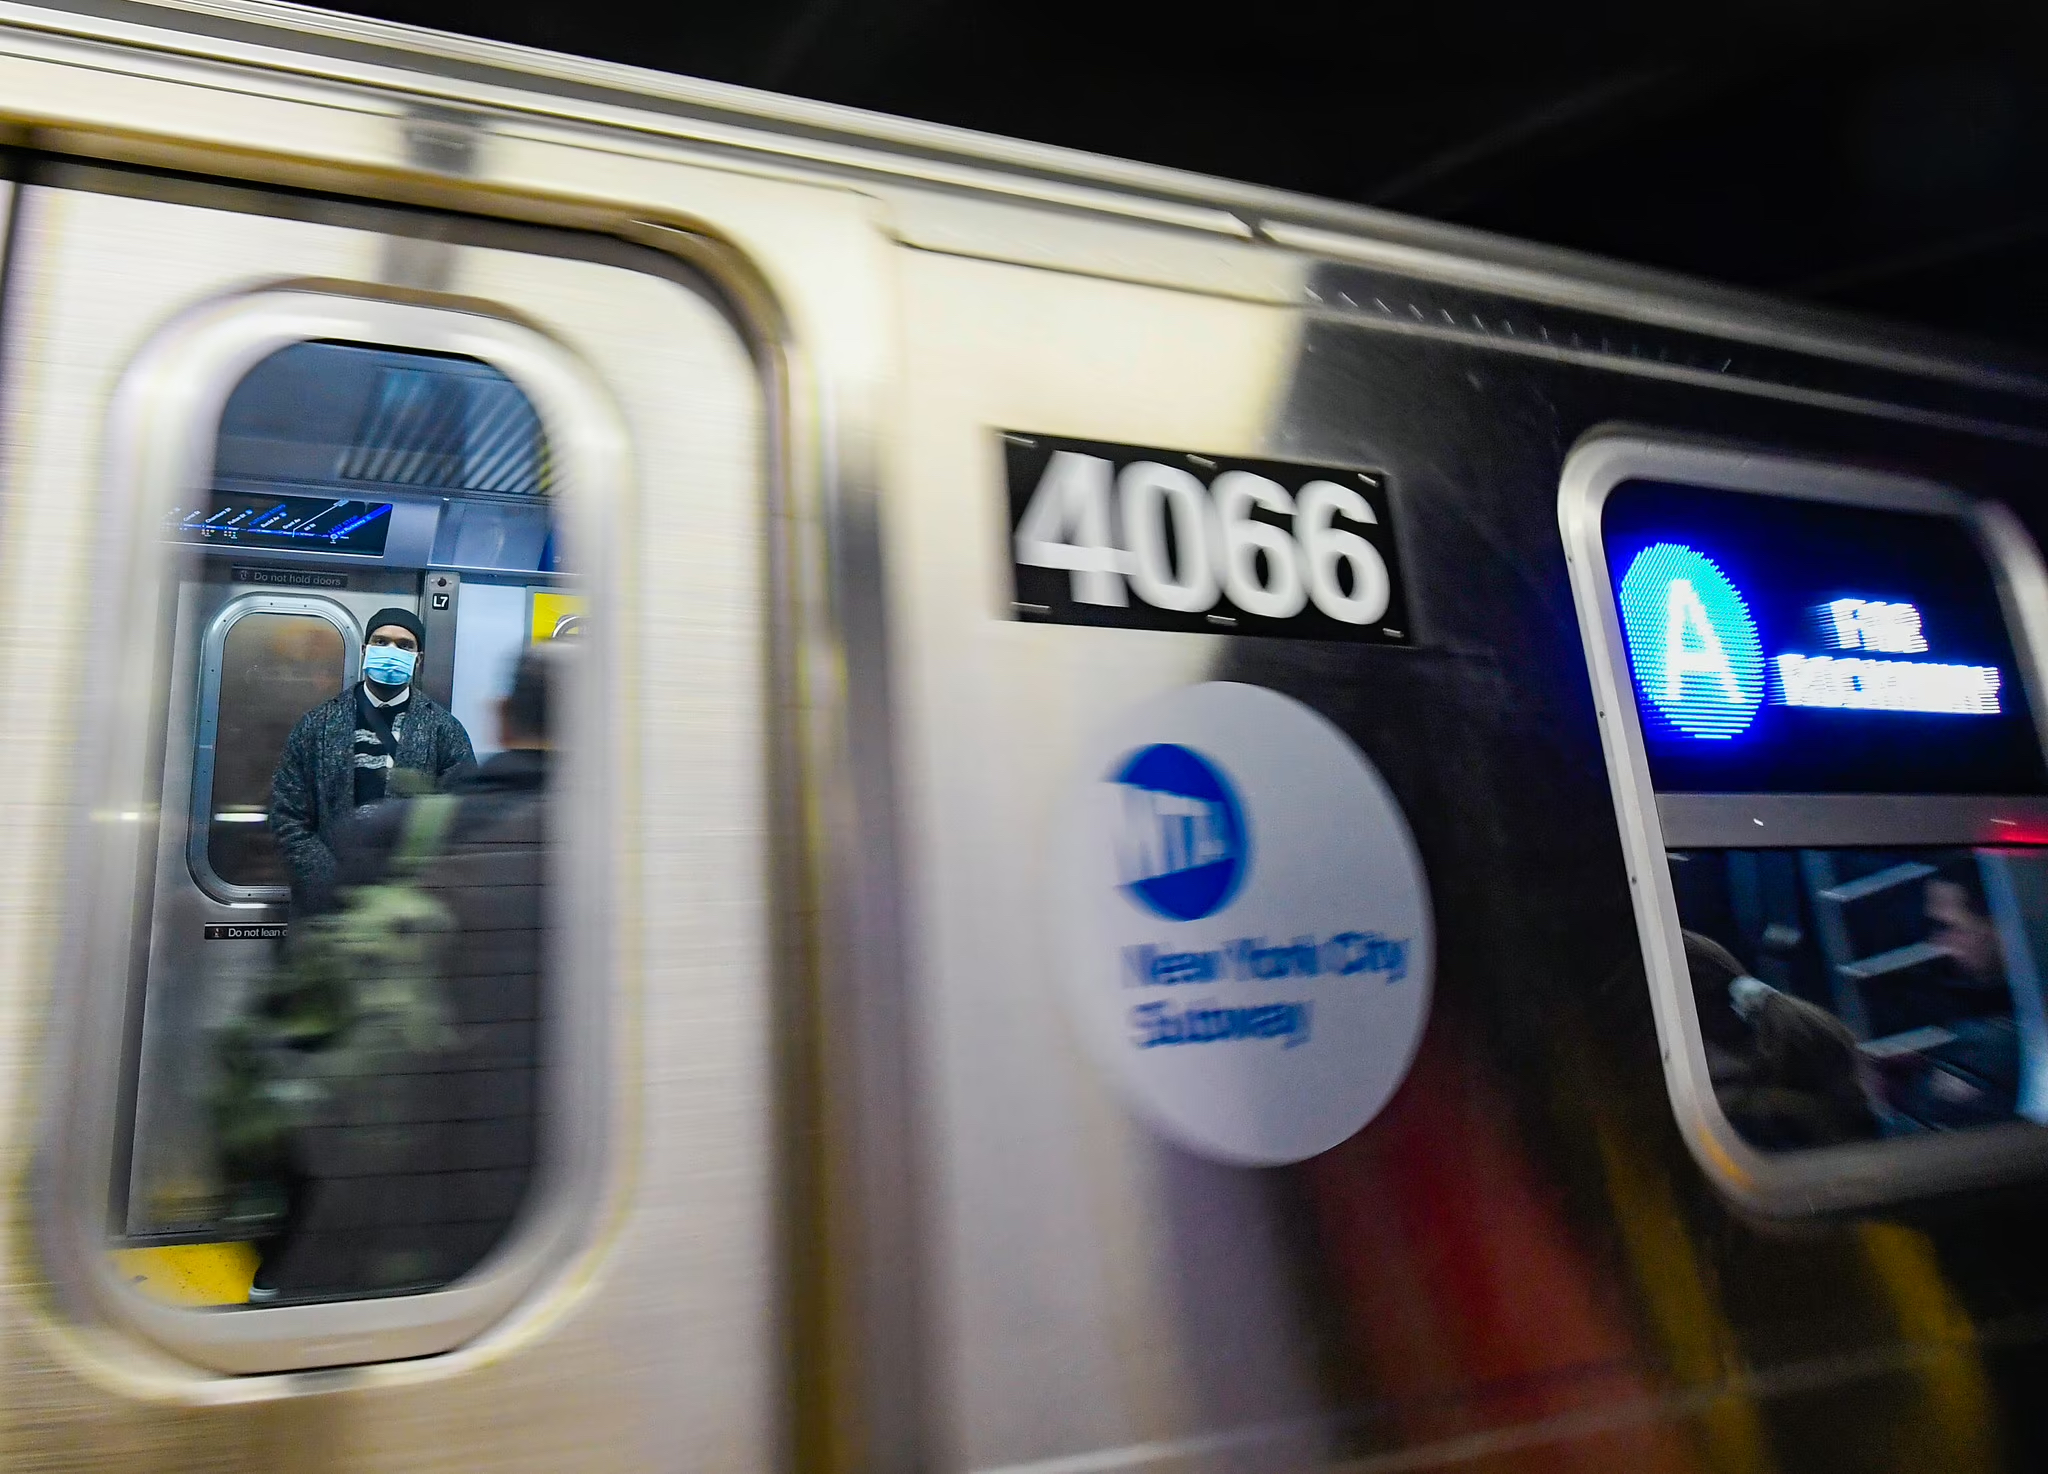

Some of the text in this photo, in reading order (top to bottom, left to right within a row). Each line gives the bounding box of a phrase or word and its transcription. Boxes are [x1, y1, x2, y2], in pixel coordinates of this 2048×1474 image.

[1014, 450, 1391, 625] 4066
[254, 572, 341, 586] Do not hold doors
[433, 595, 449, 608] L7
[1666, 578, 1746, 704] A
[228, 928, 242, 937] Do
[243, 928, 259, 937] not
[261, 928, 280, 937] lean
[1322, 931, 1409, 986] City
[1128, 999, 1313, 1050] Subway
